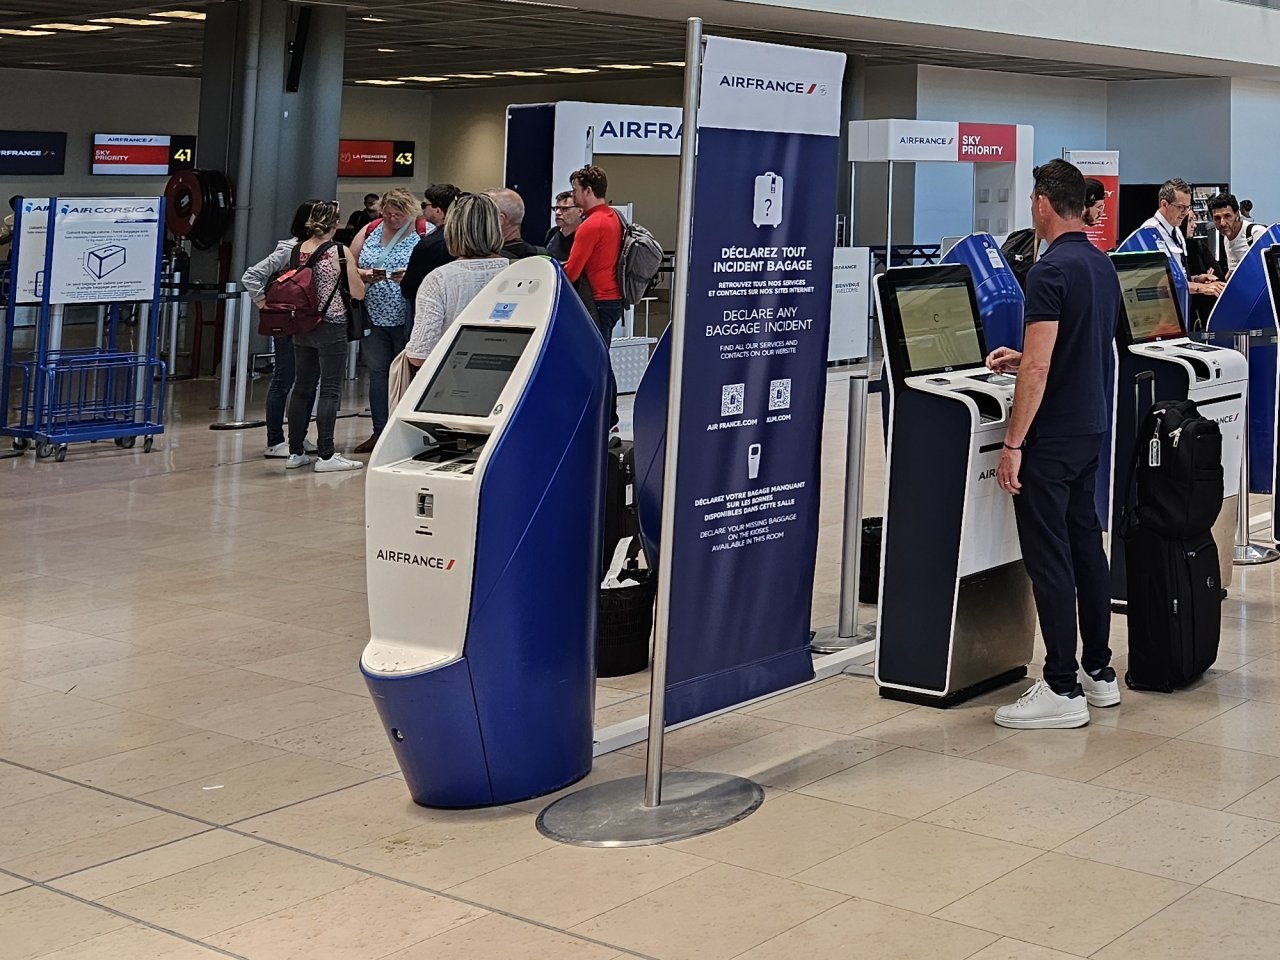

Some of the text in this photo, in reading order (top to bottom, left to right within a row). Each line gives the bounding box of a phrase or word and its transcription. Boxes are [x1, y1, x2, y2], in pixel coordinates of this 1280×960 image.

[720, 75, 804, 93] AIRFRANCE
[900, 137, 946, 145] AIRFRANCE
[962, 135, 980, 145] SKY
[174, 149, 191, 162] 41
[962, 146, 1003, 155] PRIORITY
[396, 153, 412, 165] 43
[721, 245, 806, 259] DÉCLAREZ TOUT
[714, 260, 812, 272] INCIDENT BAGAGE
[719, 281, 752, 289] RETROUVEZ
[724, 307, 798, 321] DECLARE ANY
[706, 319, 812, 337] BAGGAGE INCIDENT
[760, 341, 785, 349] SERVICES
[721, 351, 749, 359] CONTACTS
[775, 347, 796, 355] WEBSITE
[707, 419, 758, 431] AIR FRANCE.COM
[767, 414, 791, 423] KLM.COM
[978, 469, 997, 481] AIR
[695, 482, 806, 507] DÉCLAREZ VOTRE BAGAGE MANQUANT
[727, 495, 773, 509] SUR LES BORNES
[704, 499, 795, 521] DISPONIBLES DANS CETTE SALLE
[700, 514, 797, 539] DECLARE YOUR MISSING BAGGAGE
[728, 533, 738, 541] ON
[750, 526, 769, 536] KIOSKS
[711, 531, 784, 552] AVAILABLE IN THIS ROOM
[377, 549, 443, 569] AIRFRANCE
